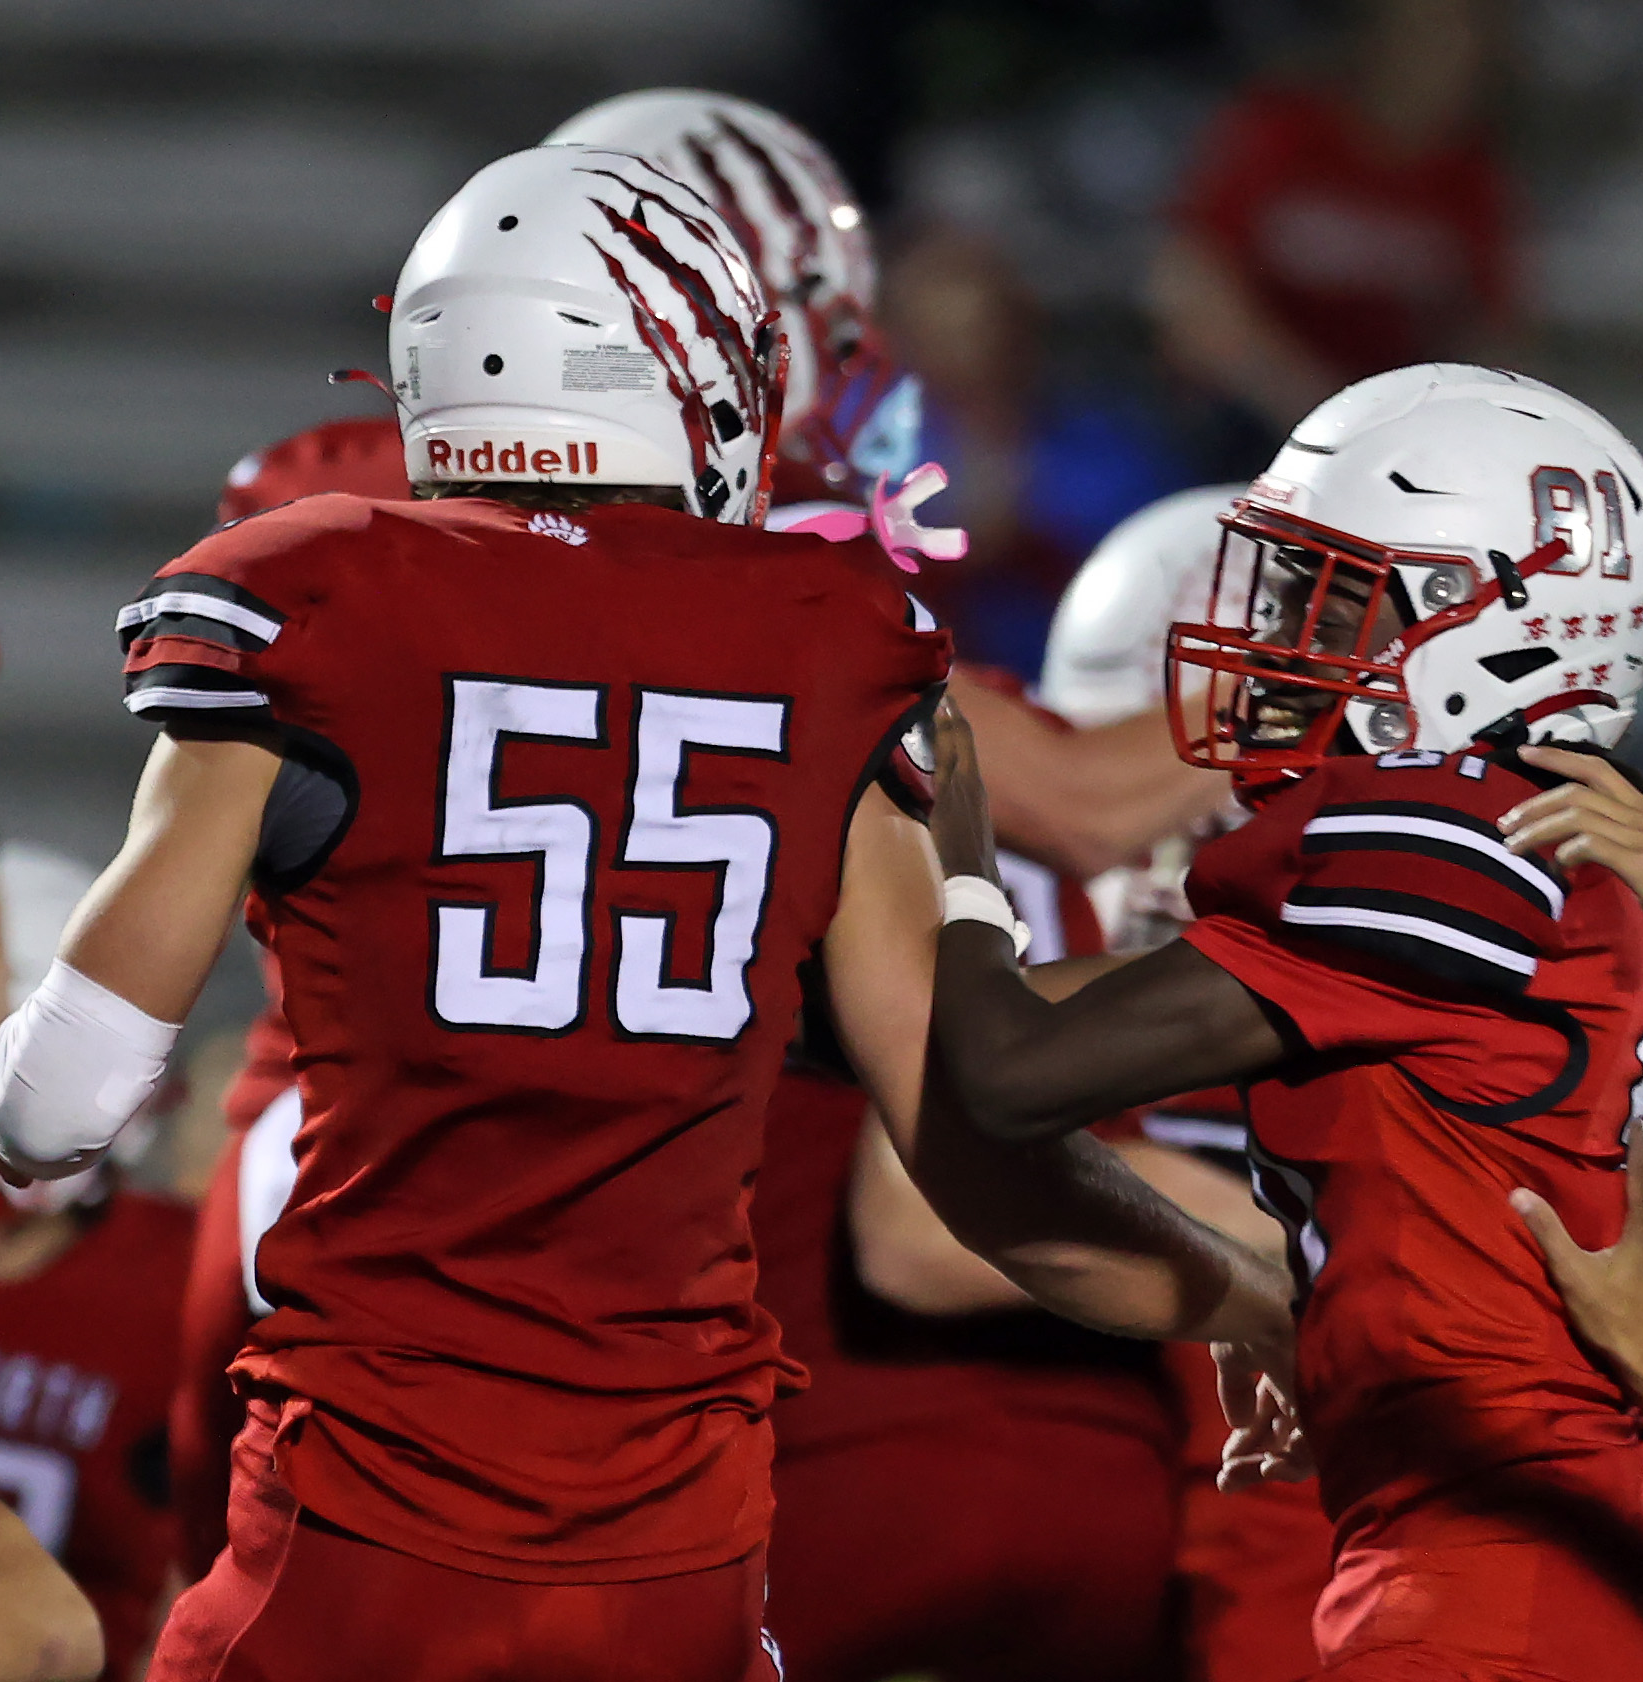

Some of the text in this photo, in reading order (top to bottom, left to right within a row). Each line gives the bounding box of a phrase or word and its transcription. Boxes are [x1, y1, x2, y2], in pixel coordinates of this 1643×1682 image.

[426, 438, 599, 475] Riddell
[1528, 464, 1633, 582] 81
[430, 672, 792, 1046] 55
